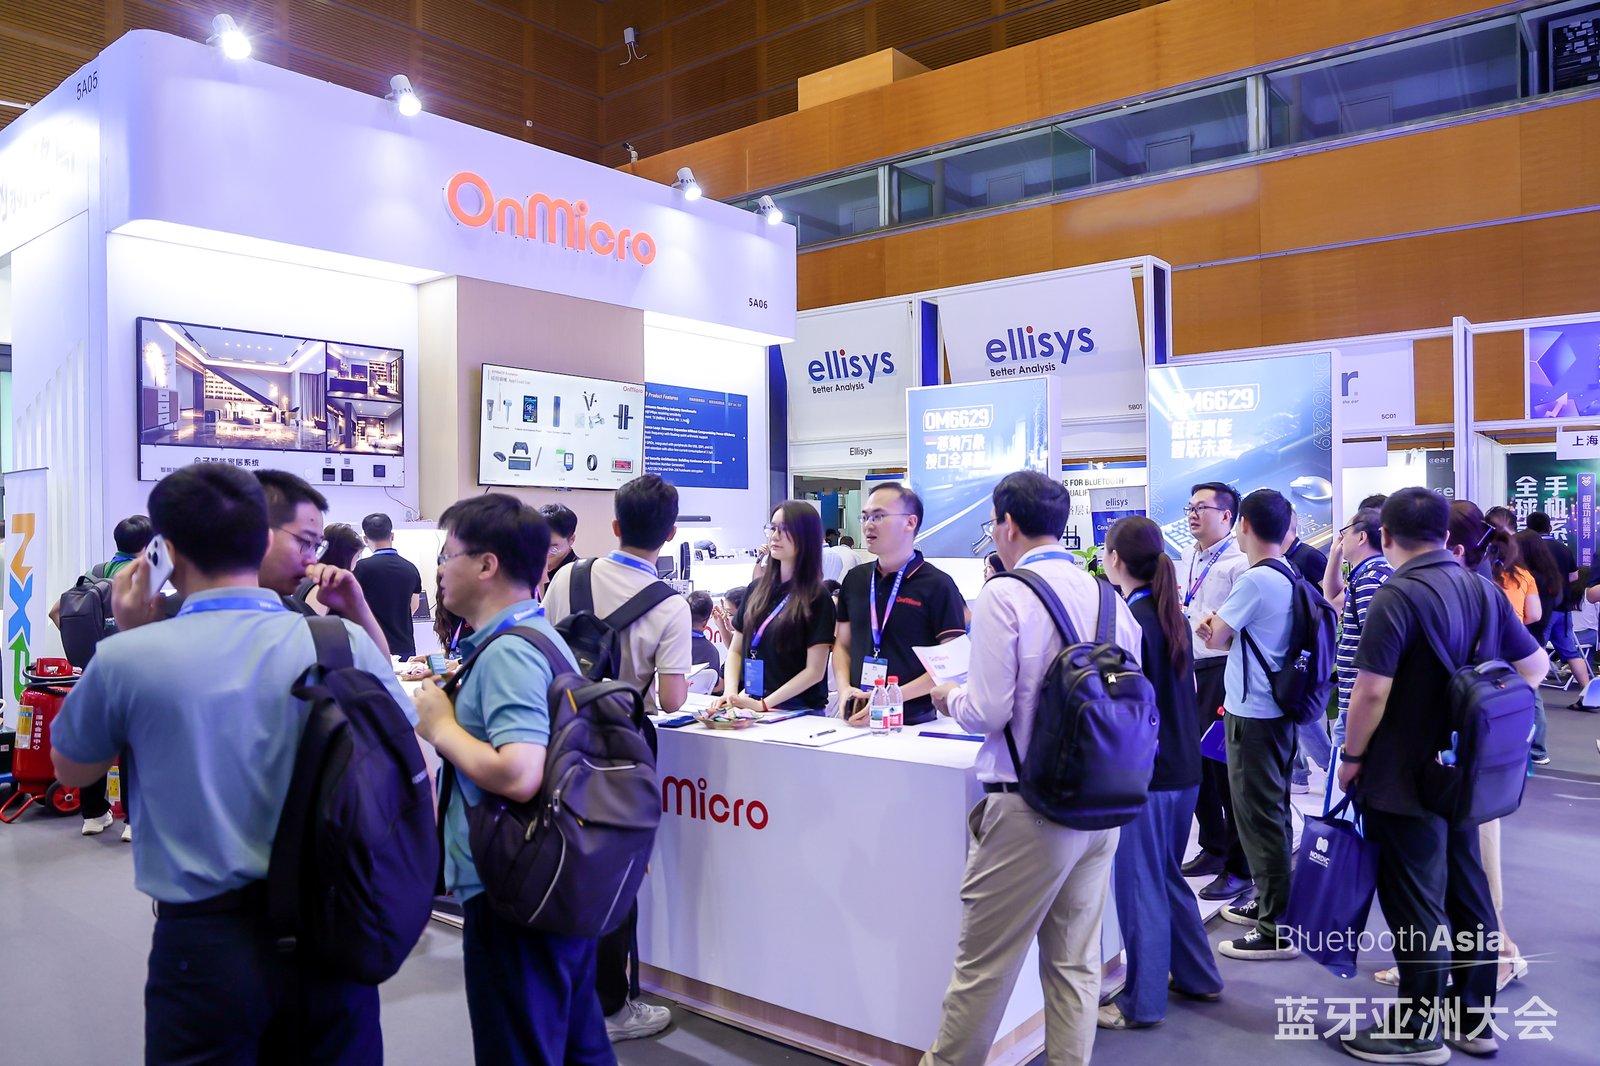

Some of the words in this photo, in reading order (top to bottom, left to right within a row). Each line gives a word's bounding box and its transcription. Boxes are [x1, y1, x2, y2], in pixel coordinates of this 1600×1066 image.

[76, 71, 98, 100] 5A05
[446, 171, 657, 265] OnMicro
[748, 297, 768, 310] 5A06
[986, 325, 1095, 365] ellisys
[808, 349, 895, 384] ellisys
[990, 367, 1016, 377] Better
[1019, 362, 1056, 374] Analysis
[812, 384, 833, 394] Better
[835, 382, 865, 392] Analysis
[1172, 388, 1255, 412] M6629
[924, 408, 989, 431] OM6629
[1572, 435, 1598, 447] 上海
[849, 447, 873, 457] Ellisys
[1070, 479, 1083, 487] FOR
[1105, 498, 1128, 507] ellisys
